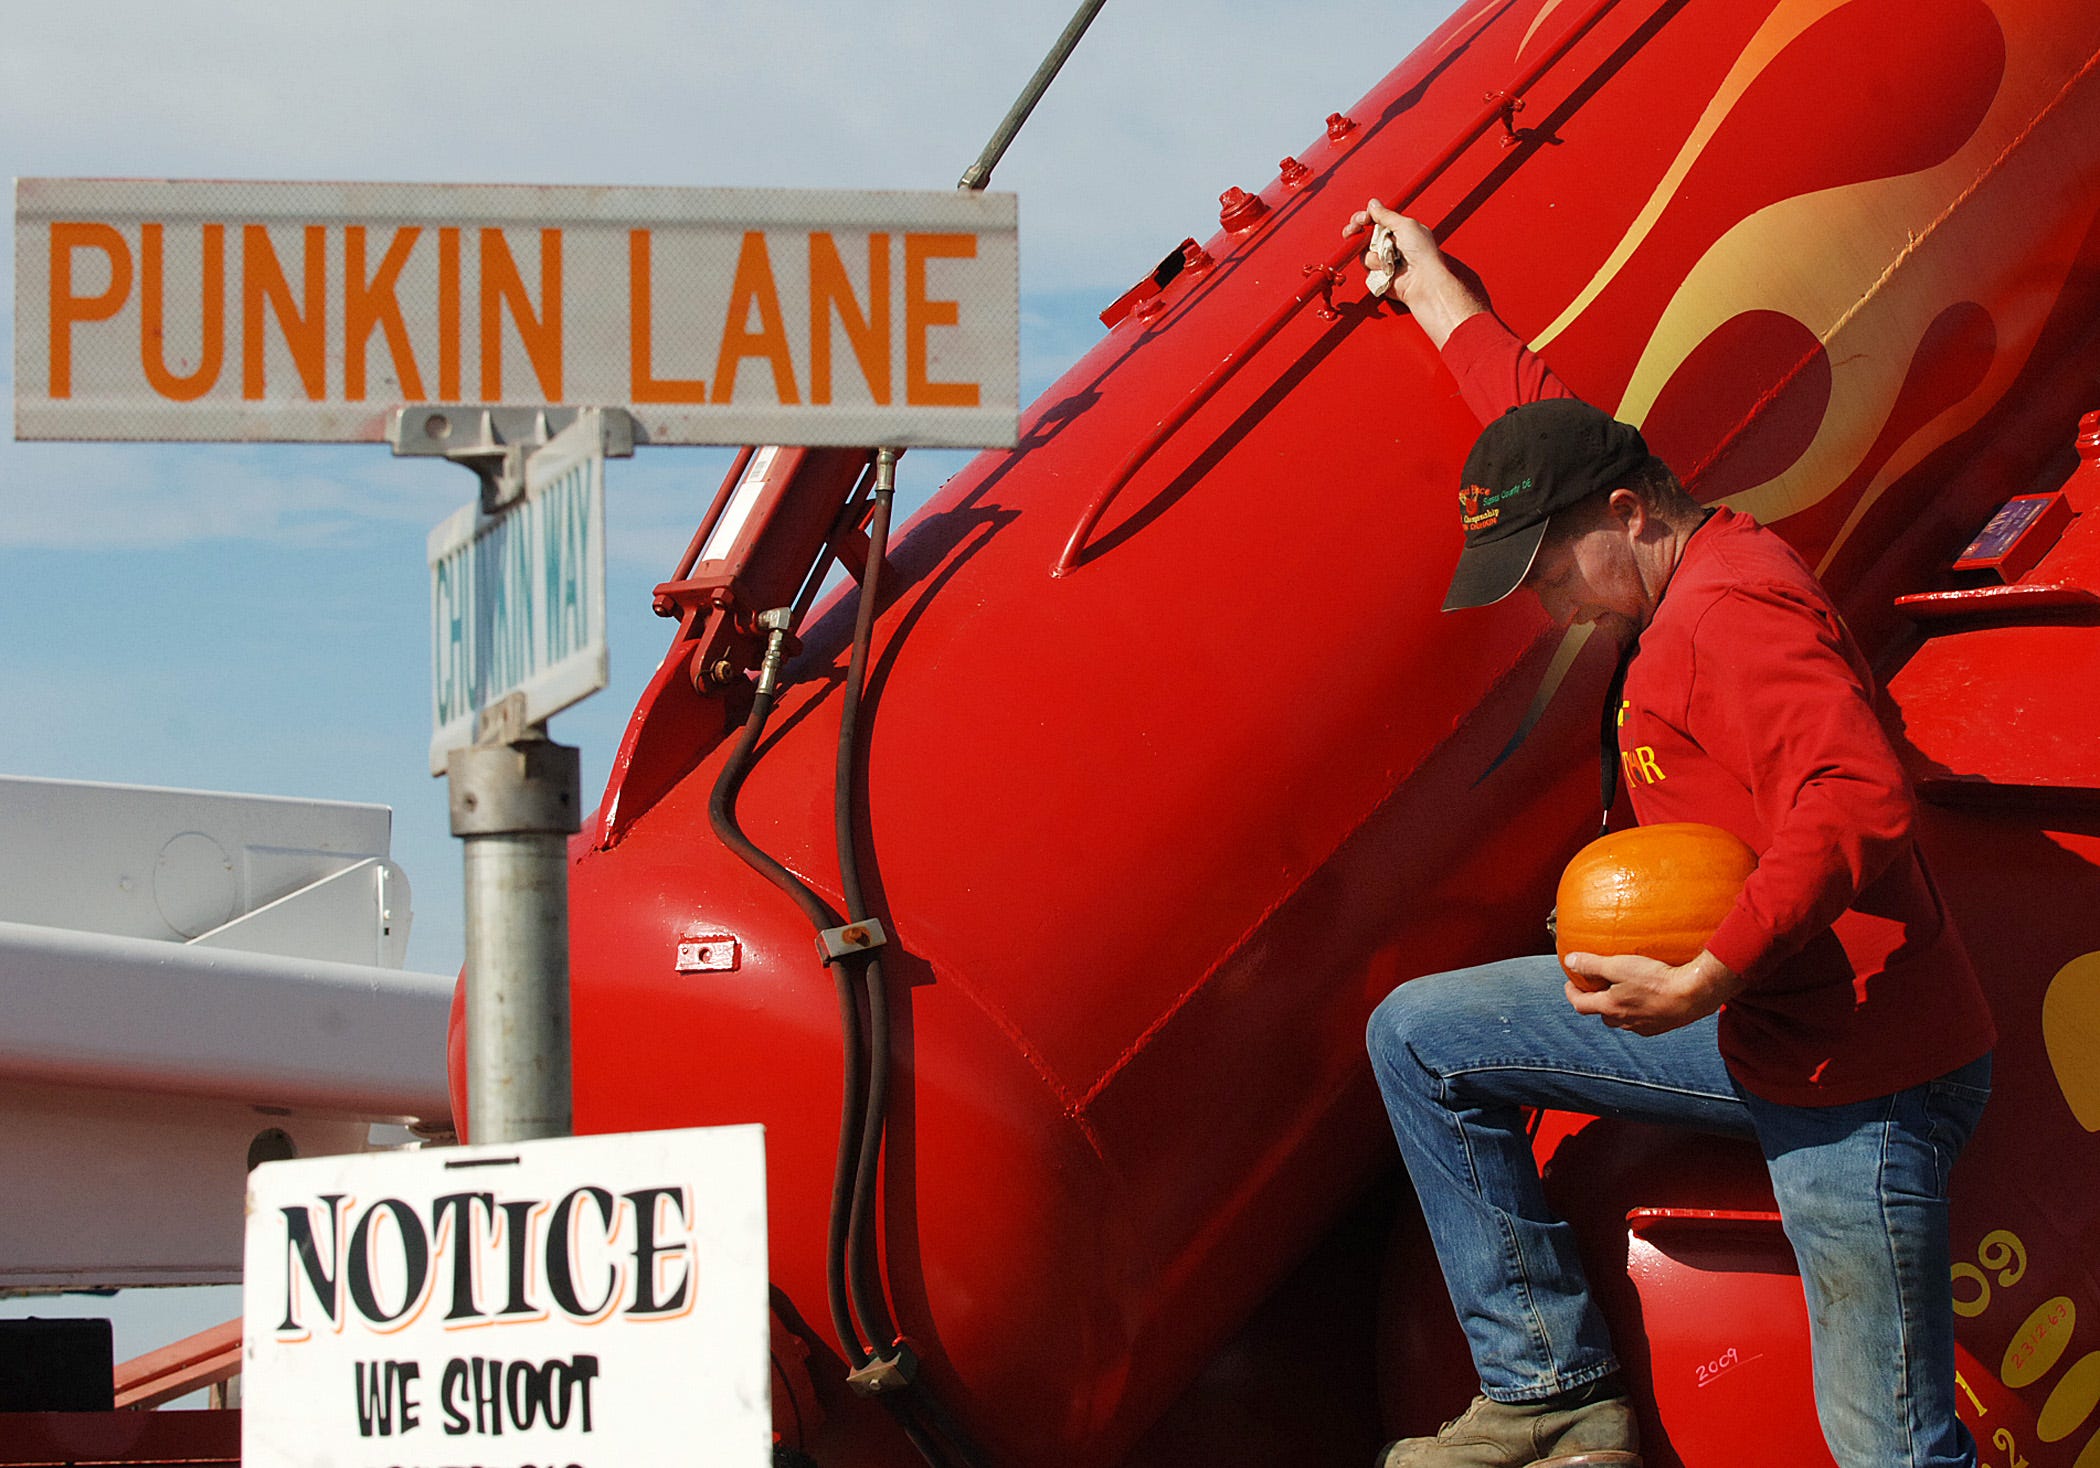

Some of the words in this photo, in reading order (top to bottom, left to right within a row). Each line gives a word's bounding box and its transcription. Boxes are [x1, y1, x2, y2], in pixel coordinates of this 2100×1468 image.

[49, 222, 563, 403] PUNKIN
[629, 228, 980, 407] LANE
[542, 458, 592, 667] WAY
[275, 1186, 697, 1341] NOTICE
[355, 1361, 420, 1437] WE
[441, 1354, 599, 1436] SHOOT
[1695, 1347, 1739, 1381] 2009
